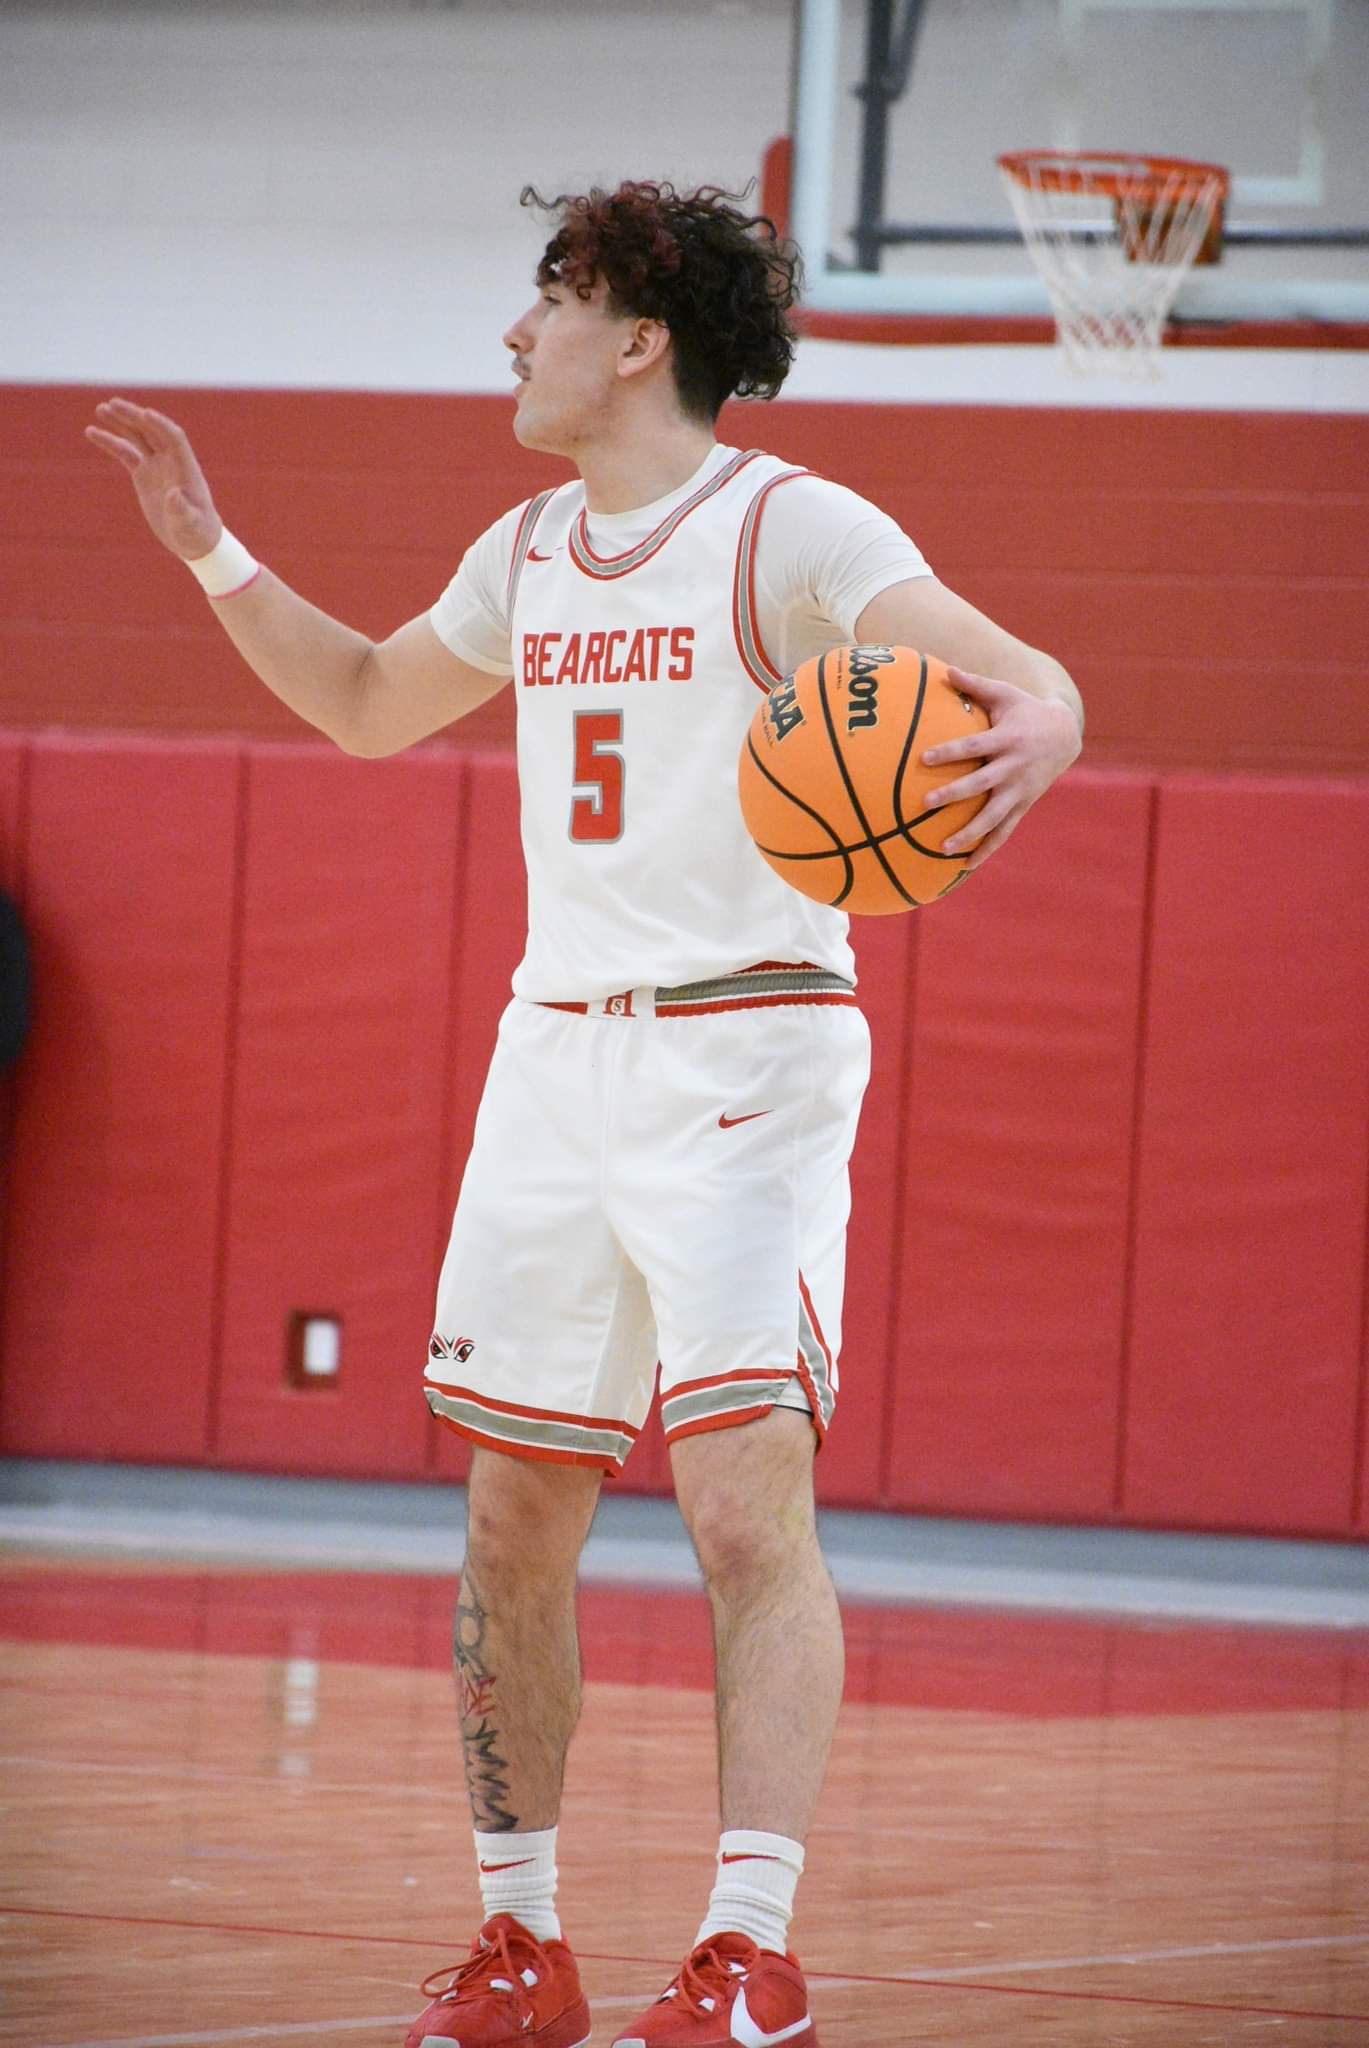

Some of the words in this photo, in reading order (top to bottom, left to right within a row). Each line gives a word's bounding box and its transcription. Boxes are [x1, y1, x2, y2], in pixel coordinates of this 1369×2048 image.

[523, 627, 695, 687] BEARCATS
[847, 646, 896, 731] ilson
[568, 708, 626, 845] 5
